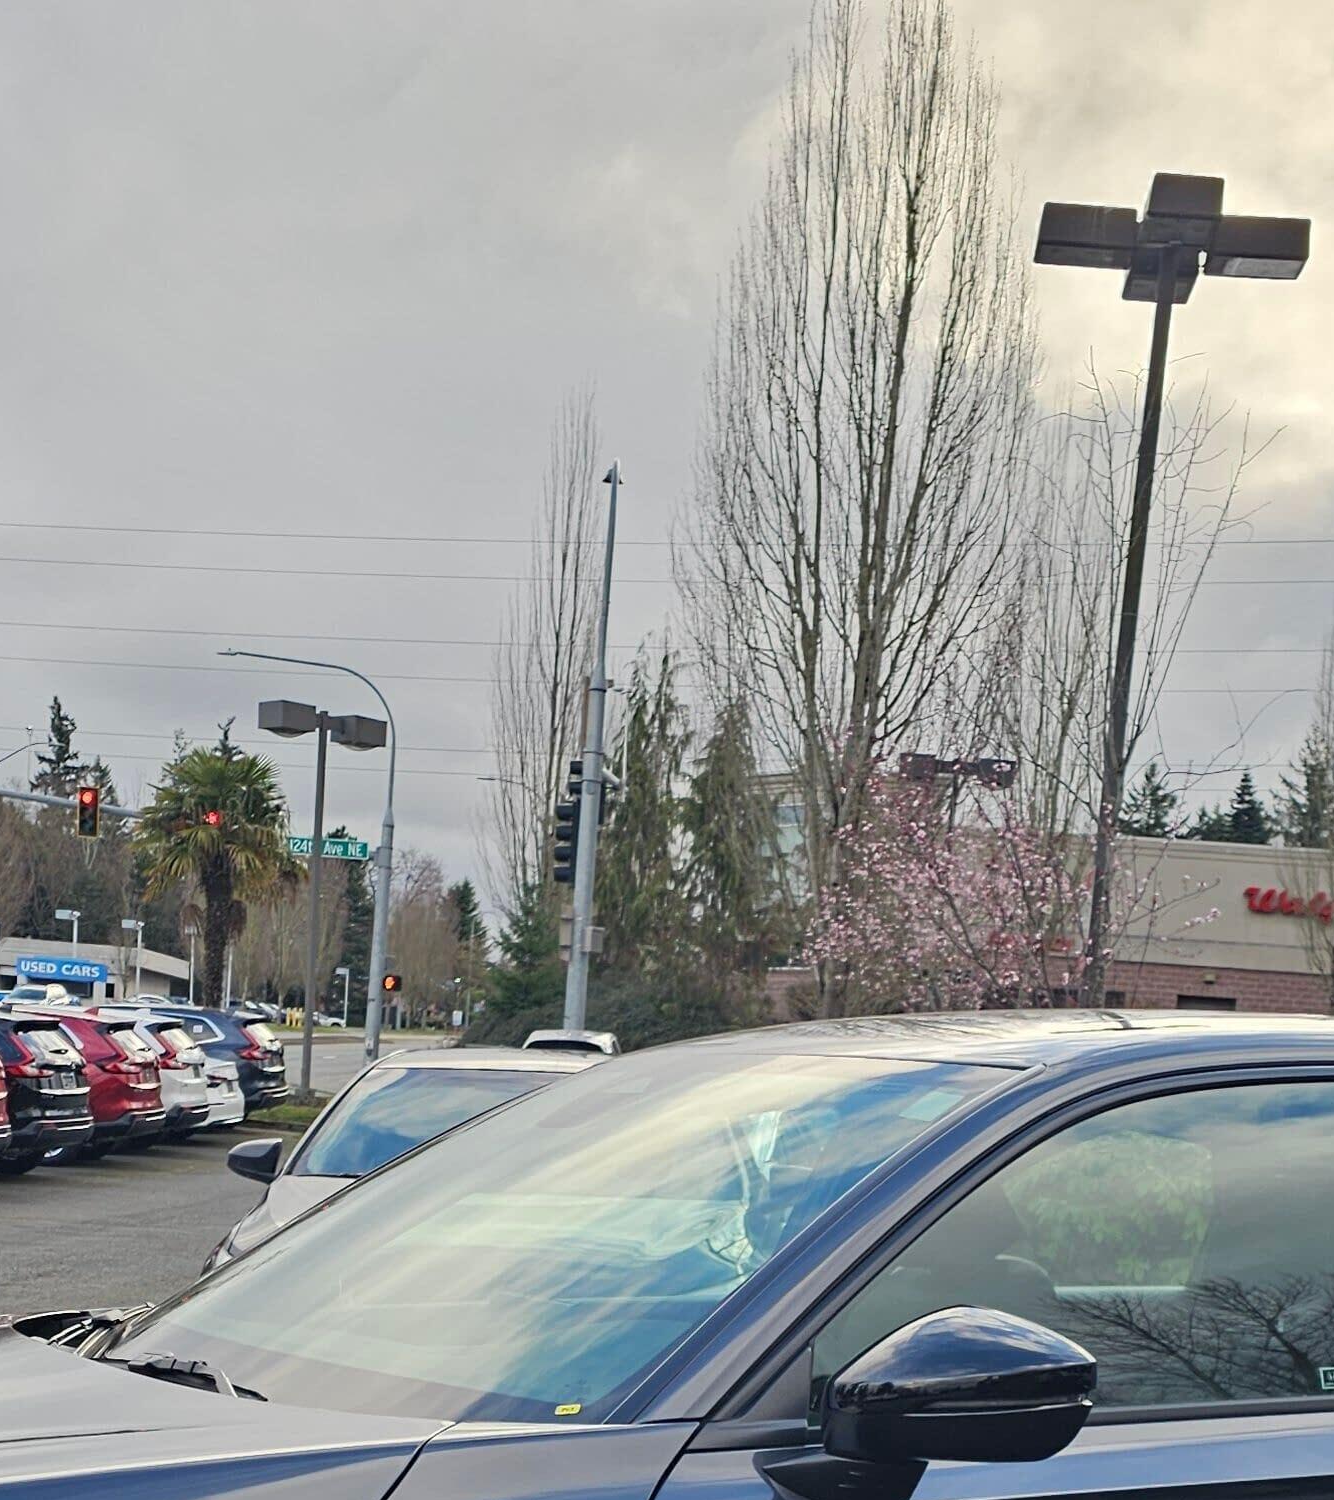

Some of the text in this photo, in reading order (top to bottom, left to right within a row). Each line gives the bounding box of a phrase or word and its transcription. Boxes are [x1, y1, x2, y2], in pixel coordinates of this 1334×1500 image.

[289, 838, 364, 857] 124t Ave NE
[20, 959, 101, 978] USED CARS
